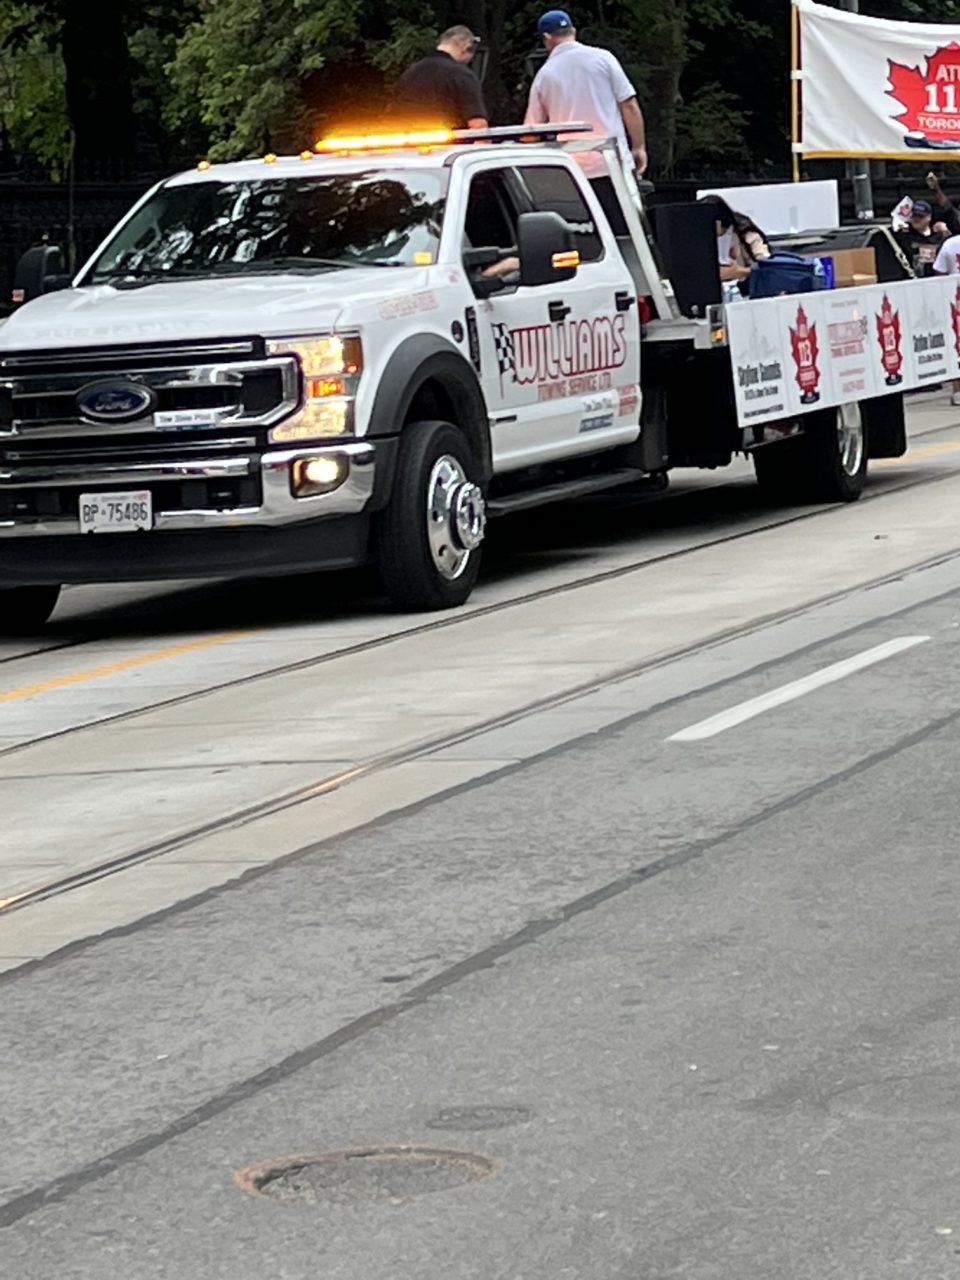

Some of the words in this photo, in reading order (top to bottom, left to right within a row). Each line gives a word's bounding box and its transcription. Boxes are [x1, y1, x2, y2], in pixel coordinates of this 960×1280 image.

[508, 314, 628, 385] WILLIAMS
[94, 393, 133, 411] Ford
[82, 504, 99, 523] BP
[107, 502, 148, 522] 75486
